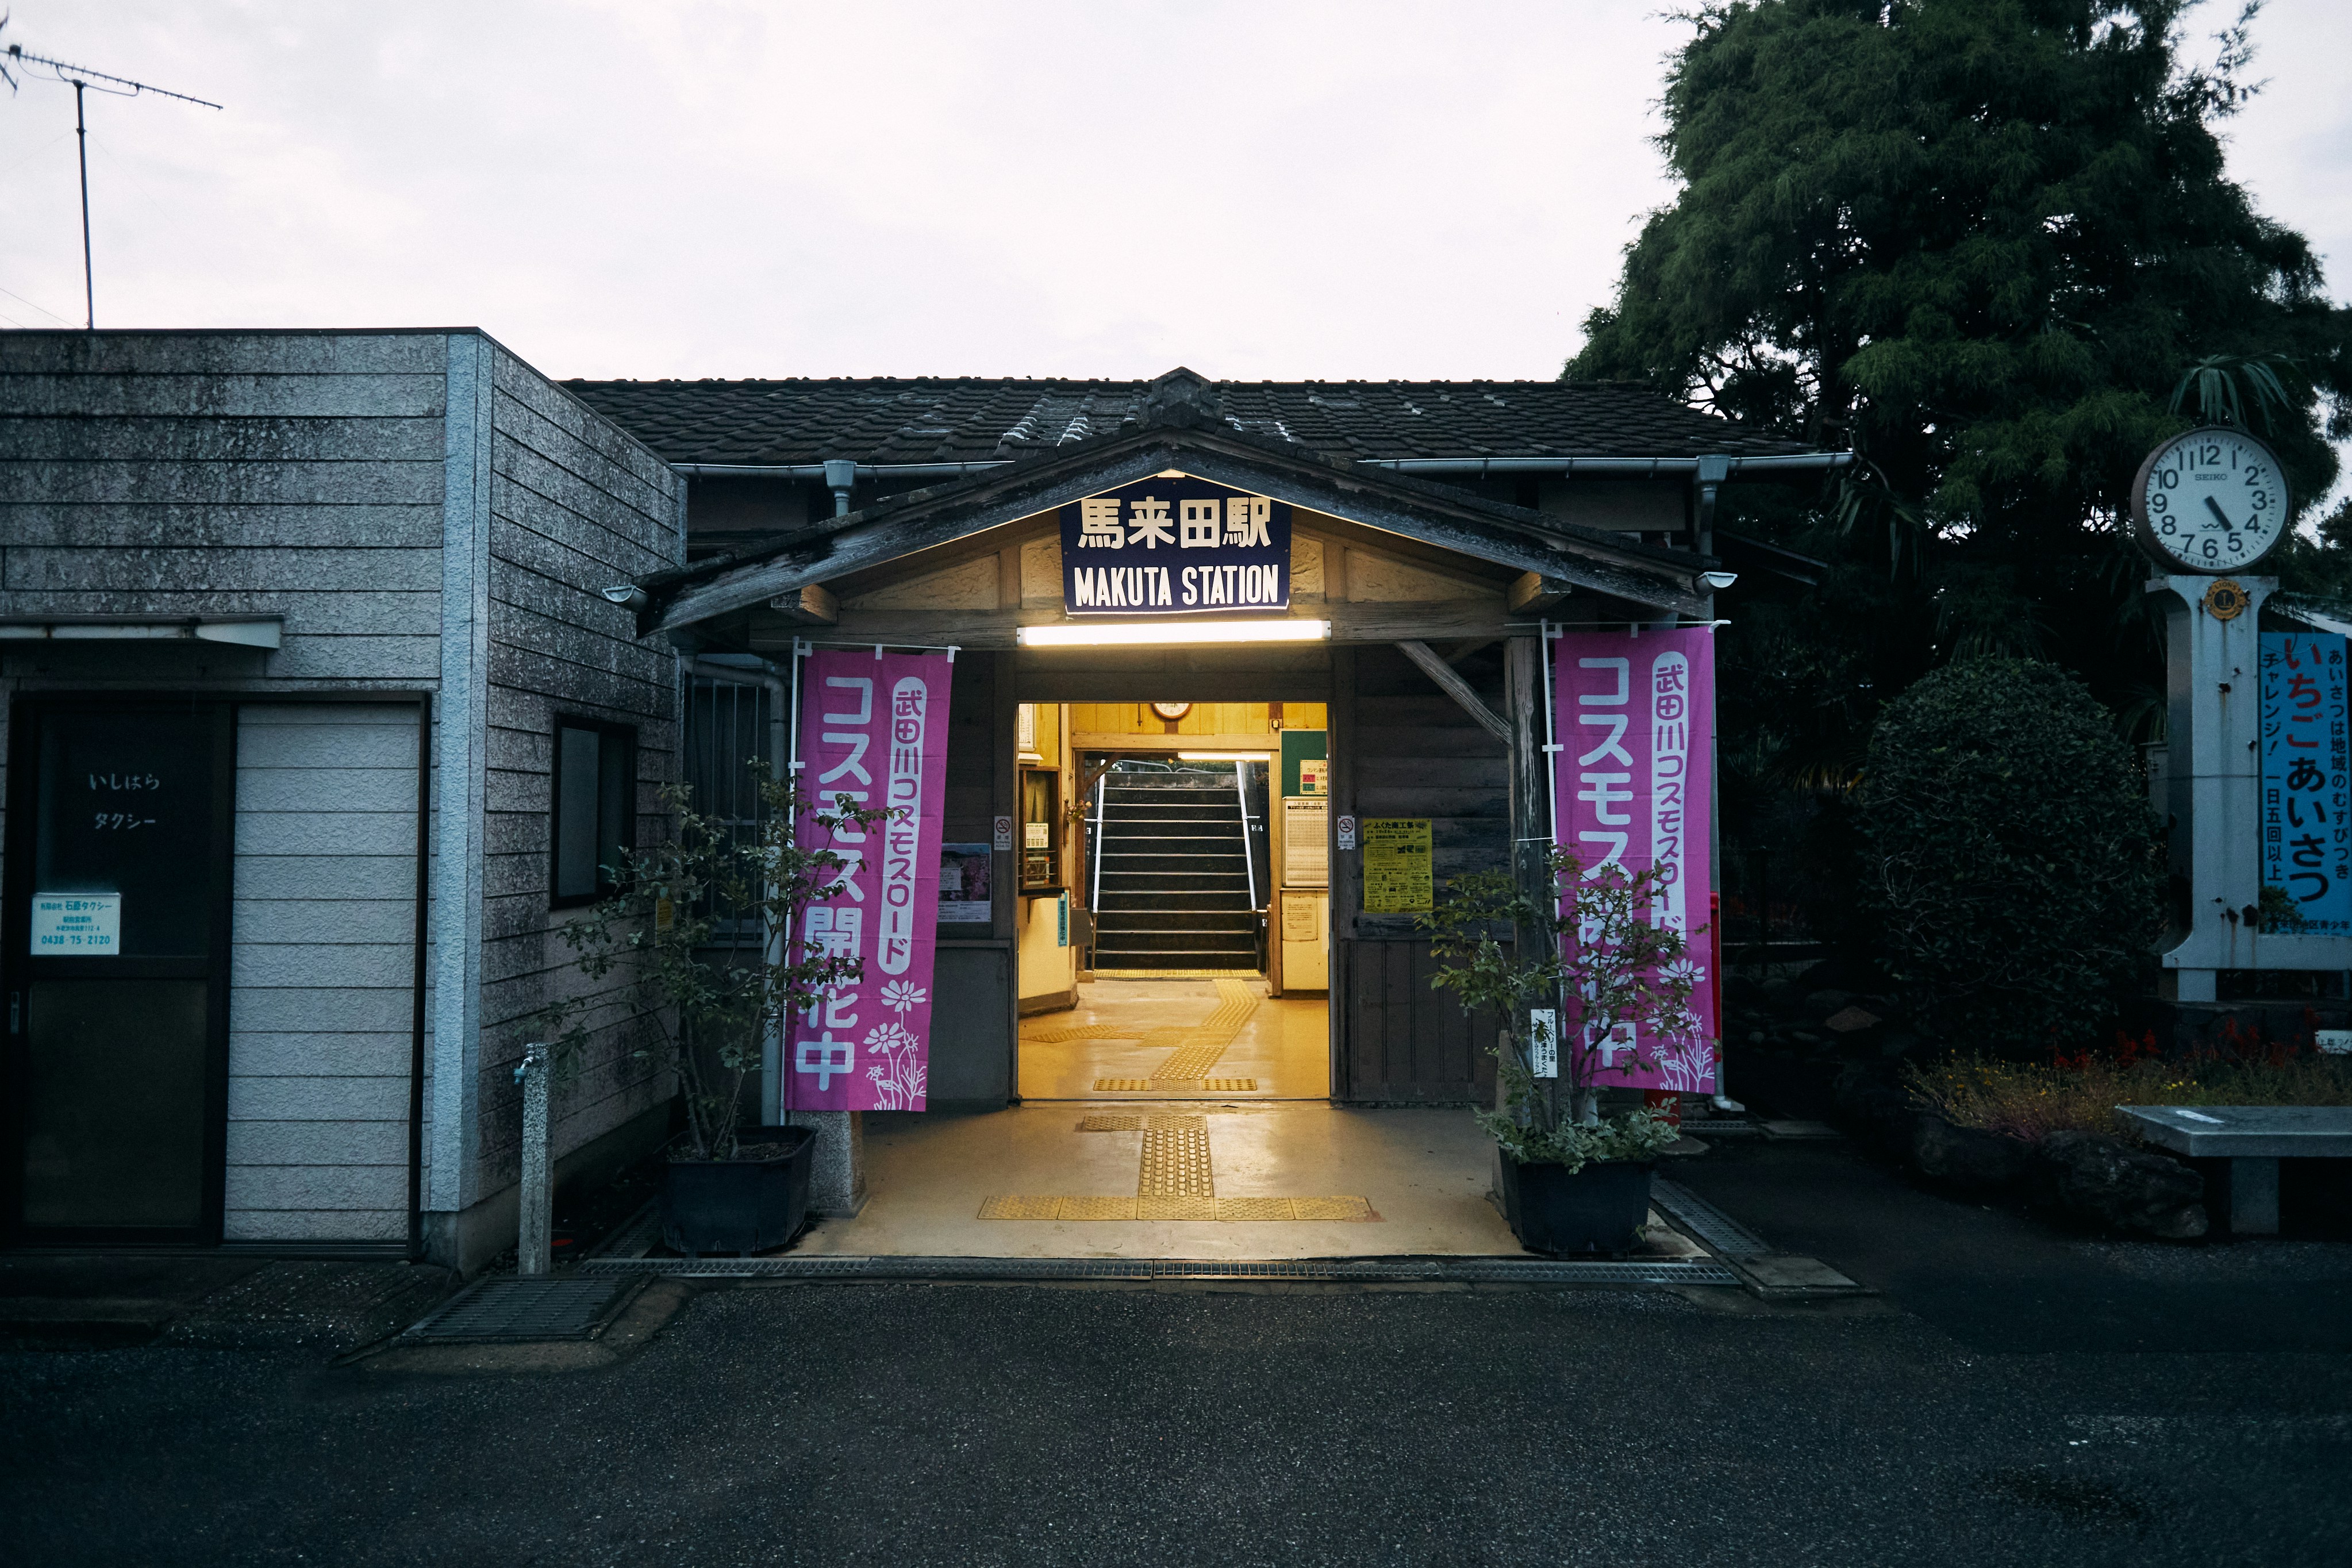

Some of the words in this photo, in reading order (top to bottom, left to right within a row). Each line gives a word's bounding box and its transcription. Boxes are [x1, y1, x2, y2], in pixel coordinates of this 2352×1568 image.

[2179, 451, 2194, 471] 11
[2200, 445, 2221, 466] 12
[2232, 450, 2236, 470] 1
[2158, 469, 2179, 490] 10
[2245, 466, 2260, 486] 2
[2152, 493, 2167, 513] 9
[2251, 490, 2268, 510] 3
[1077, 496, 1271, 549] 馬来田駅
[2161, 515, 2176, 536] 8
[2245, 514, 2261, 533] 4
[2180, 534, 2196, 553] 7
[2203, 539, 2219, 559] 6
[2227, 532, 2243, 552] 5
[1074, 567, 1172, 606] MAKUTA
[1182, 564, 1279, 605] STATION
[2284, 639, 2328, 902] いちごあいさつ
[2328, 649, 2350, 880] あいさつは地域のむすびつき
[89, 773, 160, 791] いしはら
[95, 813, 156, 830] タクシー
[885, 690, 923, 964] 武田川コスモスロード
[2265, 776, 2284, 882] 一日五回以上
[795, 677, 873, 1092] コスモス開花中
[66, 901, 112, 910] 石原タクシー
